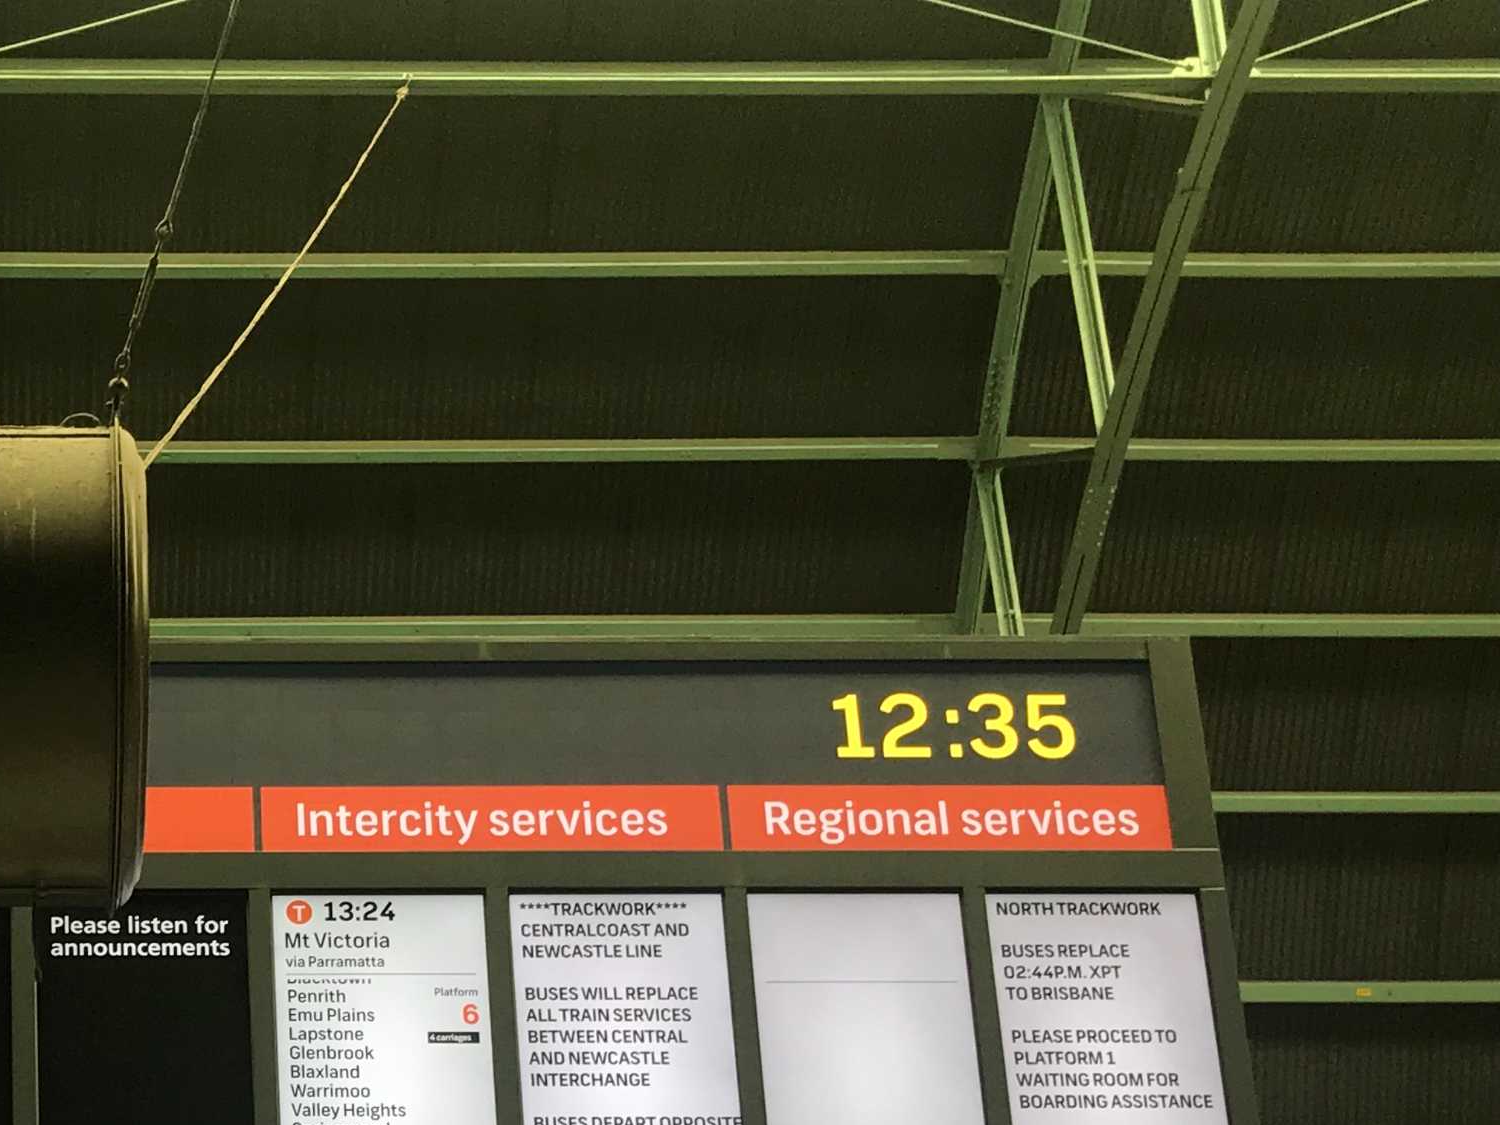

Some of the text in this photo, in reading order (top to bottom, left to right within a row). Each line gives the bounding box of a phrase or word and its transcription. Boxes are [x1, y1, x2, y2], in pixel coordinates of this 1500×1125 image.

[833, 693, 1075, 759] 12:35
[297, 801, 667, 845] Intercity services
[764, 800, 1139, 844] Regional services
[324, 902, 395, 921] 13:24
[996, 902, 1160, 915] NORTH TRACKWORK
[285, 932, 389, 948] Mt Victoria
[523, 945, 662, 958] NEWCASTLE LINE
[1001, 944, 1129, 958] BUSES REPLACE
[286, 956, 384, 967] via Parramatta
[288, 989, 345, 1003] Penrith
[434, 987, 478, 996] Platform
[525, 987, 698, 1000] BUSES WILL REPLACE
[1005, 987, 1114, 1000] TO BRISBANE
[289, 1008, 374, 1021] Emu Plains
[463, 1004, 479, 1024] 6
[289, 1027, 363, 1043] Lapstone
[528, 1030, 688, 1043] BETWEEN CENTRAL
[290, 1045, 373, 1059] Glenbrook
[1014, 1051, 1115, 1065] PLATFORM 1
[291, 1065, 359, 1078] Blaxland
[531, 1073, 650, 1087] INTERCHANGE
[290, 1084, 370, 1097] Warrimoo
[1019, 1094, 1213, 1109] BOARDING ASSISTANCE
